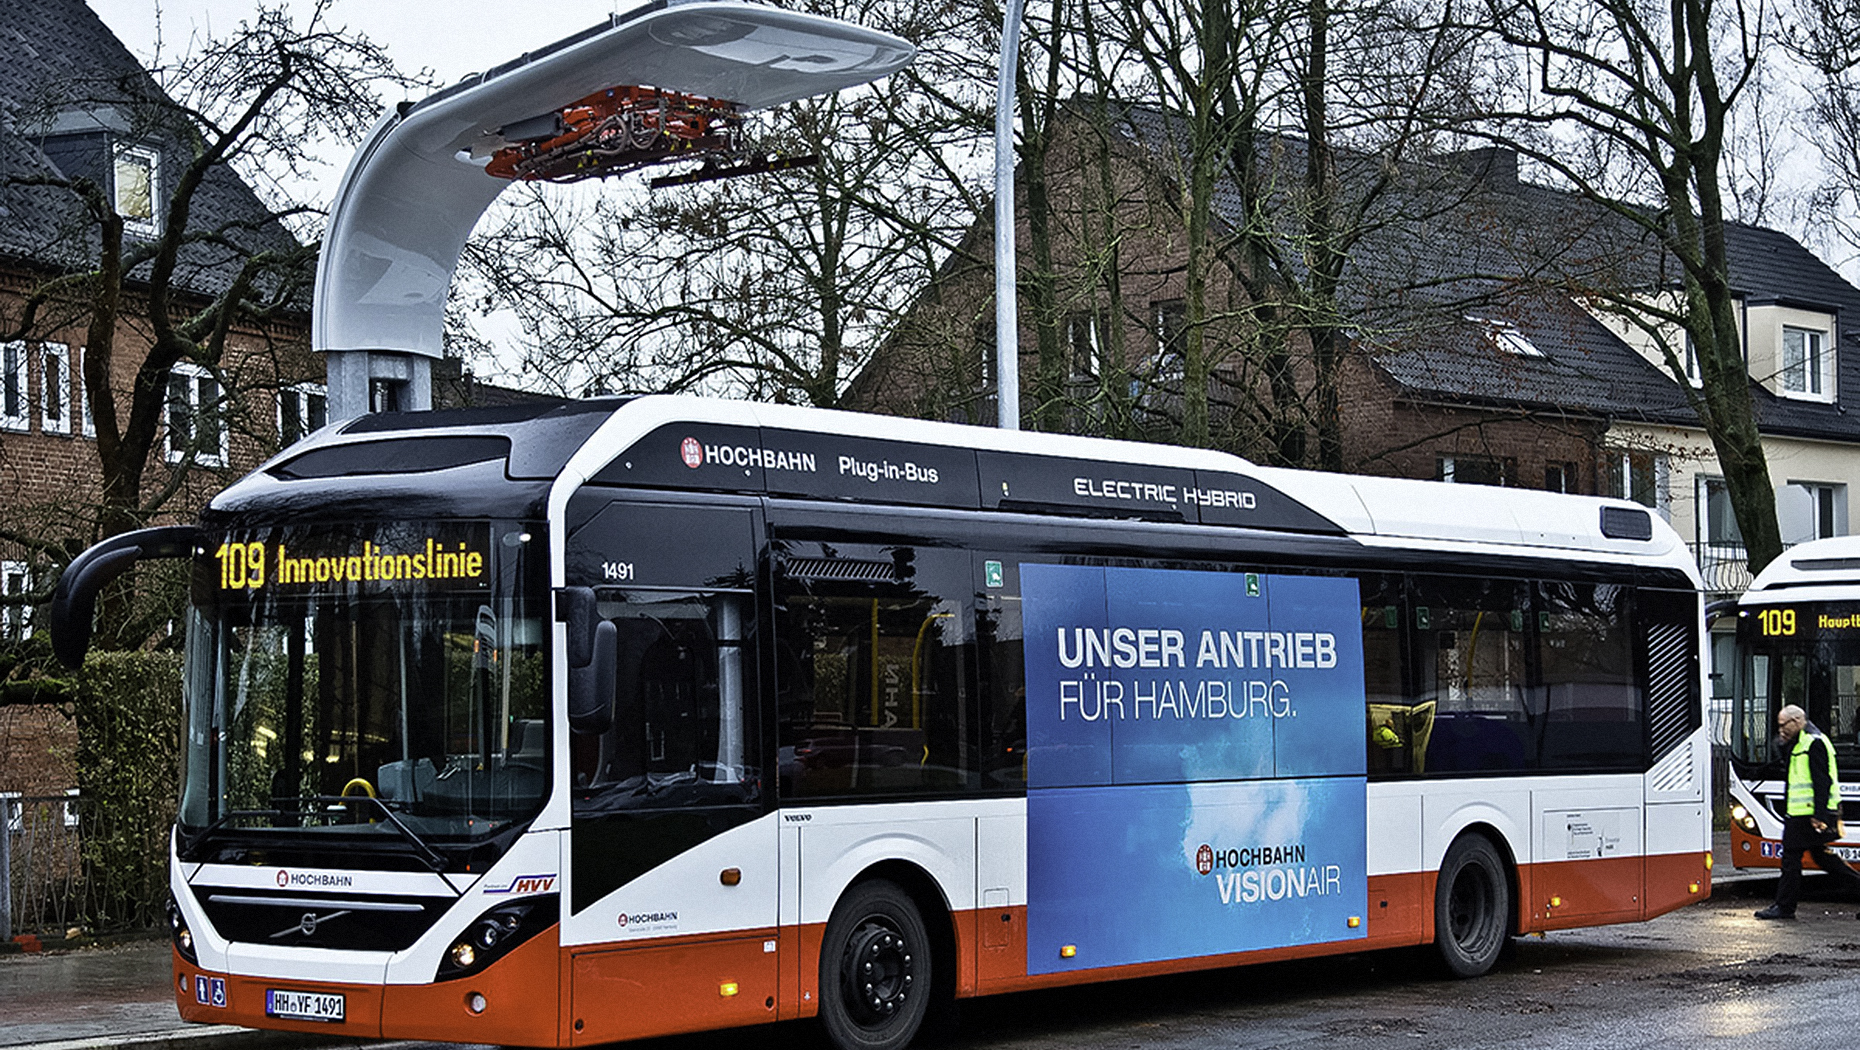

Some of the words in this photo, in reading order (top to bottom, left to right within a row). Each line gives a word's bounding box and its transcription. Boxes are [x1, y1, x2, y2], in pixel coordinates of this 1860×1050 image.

[704, 443, 816, 473] HOCHBAHN
[838, 455, 939, 484] Plug-in-Bus
[1073, 477, 1177, 502] ELECTRIC
[1183, 487, 1257, 510] HYBRID
[214, 540, 266, 590] 109
[277, 537, 484, 584] Innovationslinie
[601, 562, 635, 581] 1491
[1757, 609, 1796, 636] 109
[1057, 627, 1186, 669] UNSER
[1196, 630, 1338, 669] ANTRIEB
[1059, 672, 1125, 721] FÜR
[1134, 679, 1297, 720] HAMBURG.
[1215, 844, 1306, 869] HOCHBAHN
[290, 873, 353, 887] HOCHBAHN
[516, 878, 555, 893] HVV
[1215, 864, 1341, 905] VISIONAIR
[628, 911, 678, 924] HOCHBAHN
[314, 996, 343, 1016] 1491
